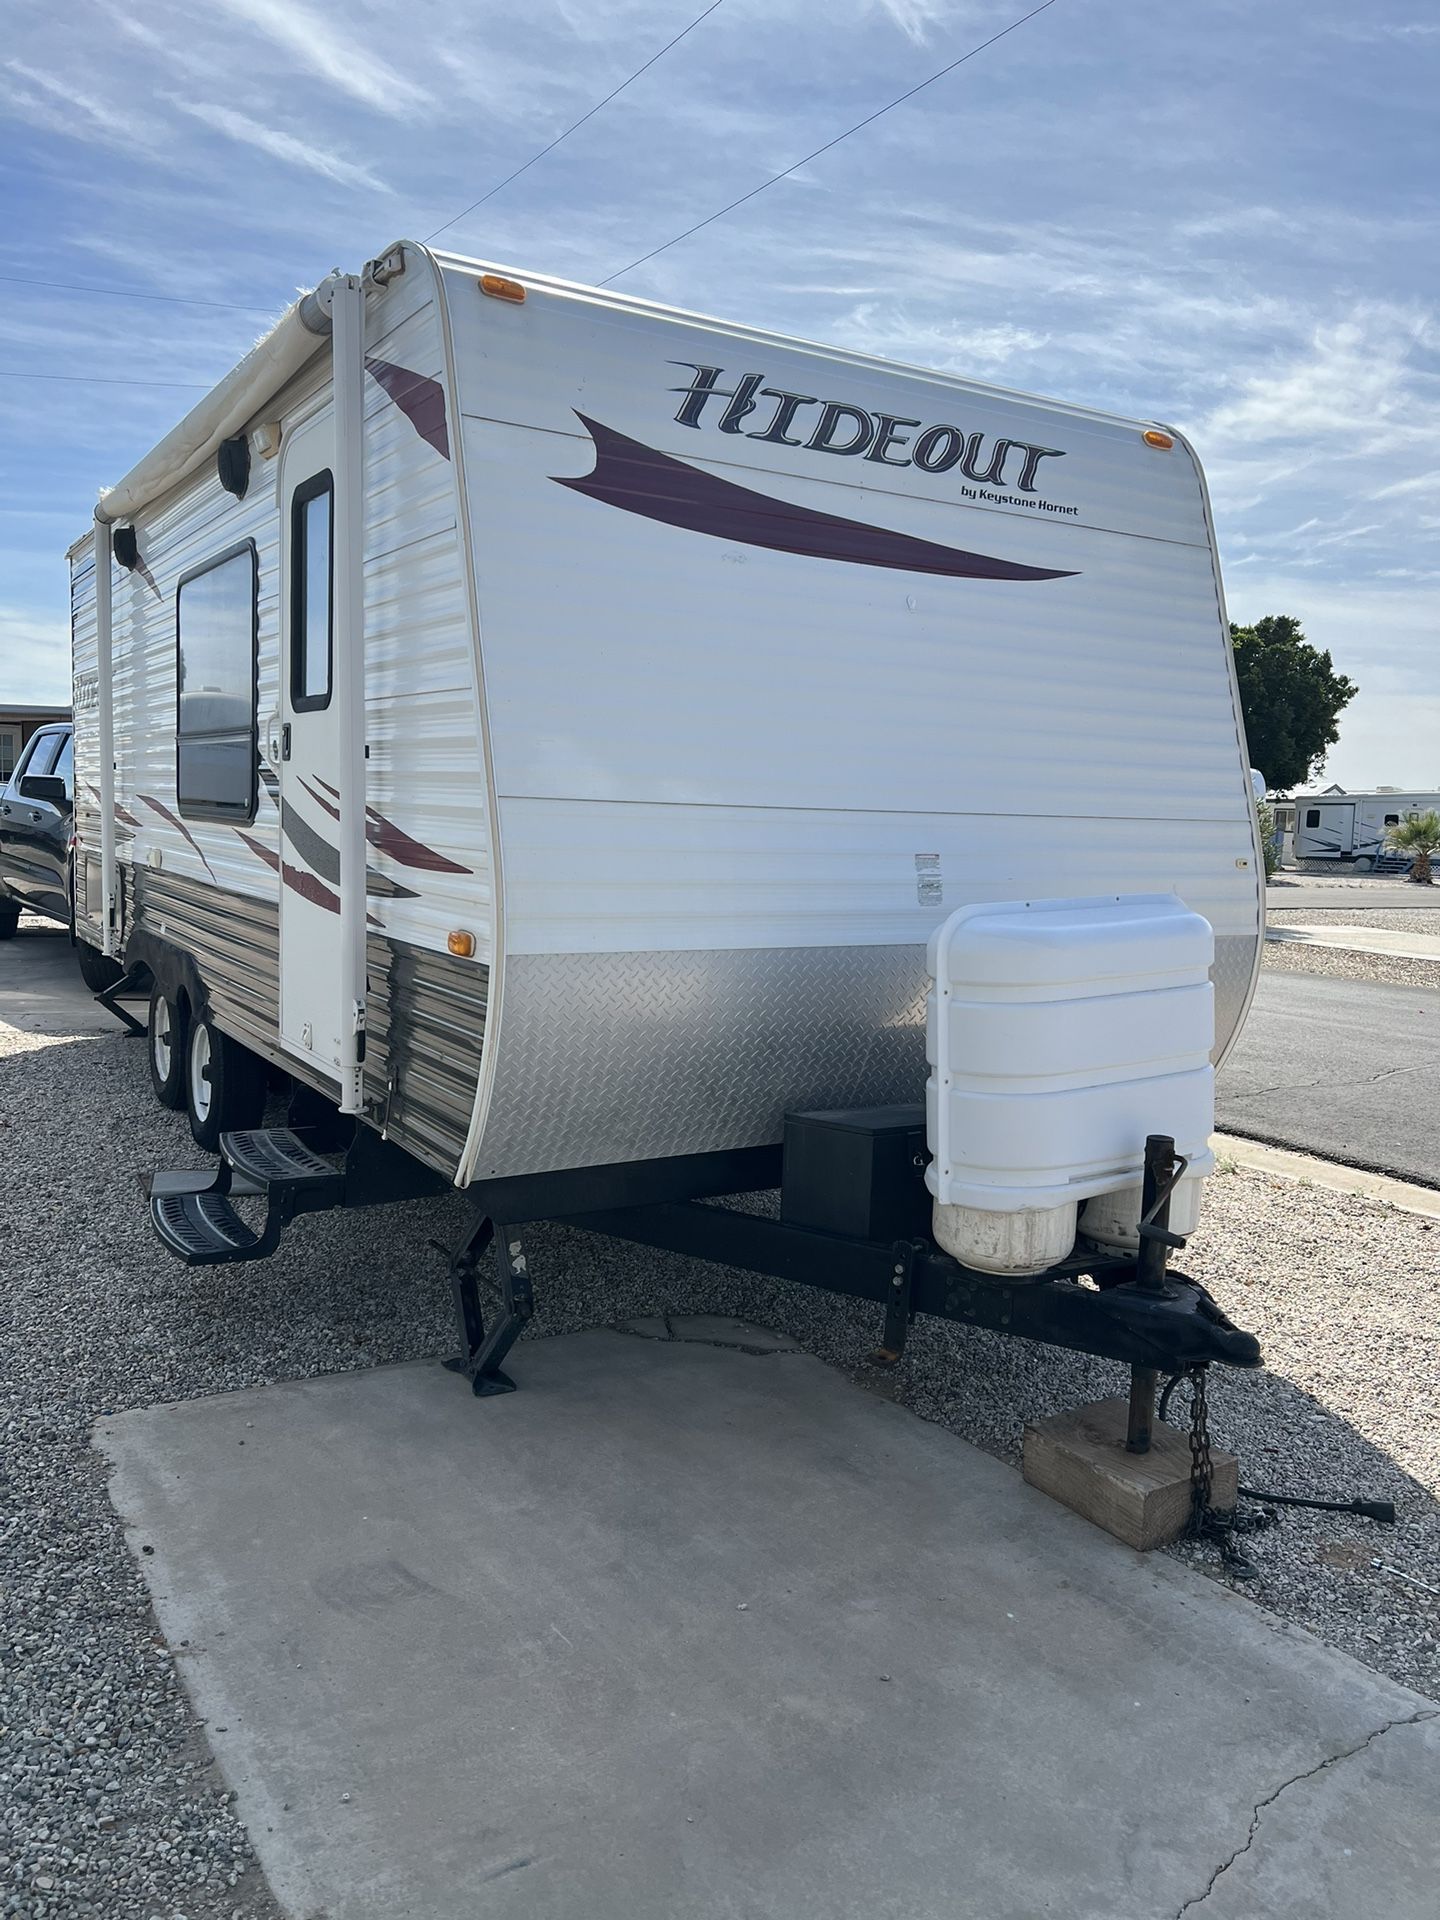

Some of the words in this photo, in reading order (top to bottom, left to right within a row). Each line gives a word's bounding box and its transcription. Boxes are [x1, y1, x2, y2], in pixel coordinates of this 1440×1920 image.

[666, 360, 1067, 493] HIDEOUT
[961, 485, 977, 500] by
[979, 489, 1036, 509] Keystone
[1038, 499, 1079, 516] Hornet
